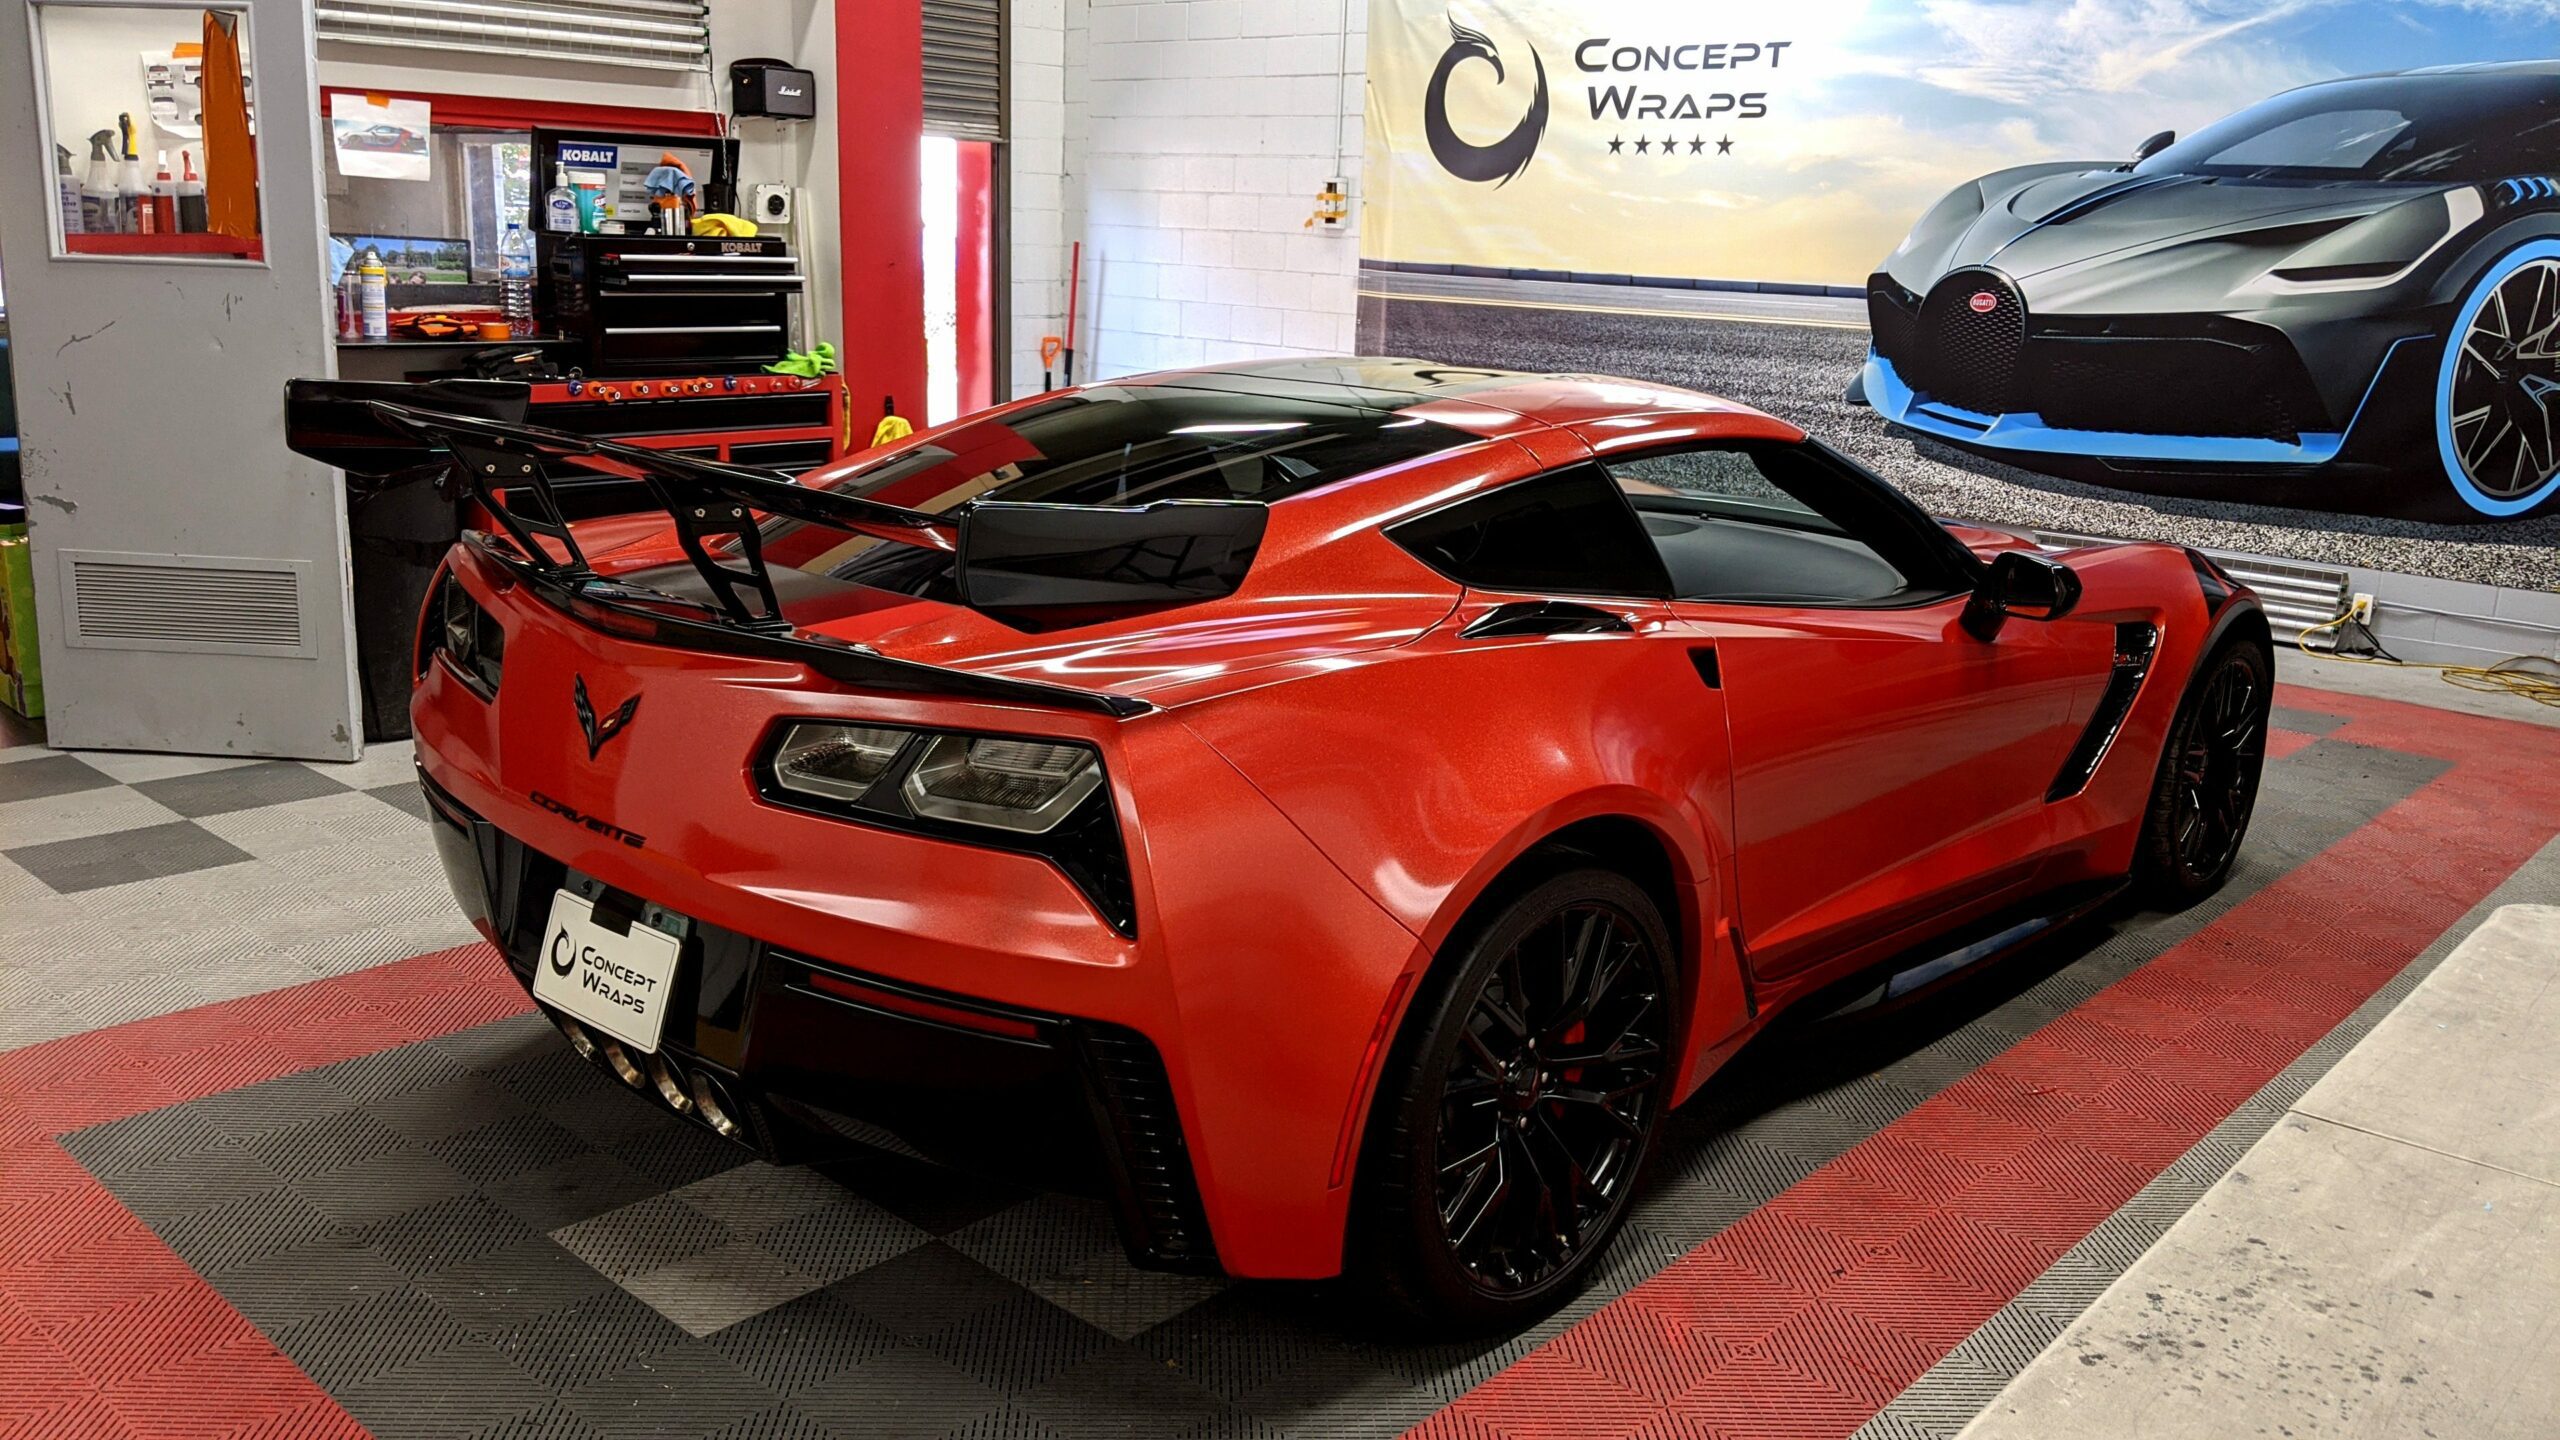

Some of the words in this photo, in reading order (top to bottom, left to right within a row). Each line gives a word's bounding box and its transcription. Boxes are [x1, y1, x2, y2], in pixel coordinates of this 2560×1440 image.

[562, 149, 614, 163] KOBALT
[721, 242, 763, 253] KOBALT
[529, 790, 647, 849] CORVETTE
